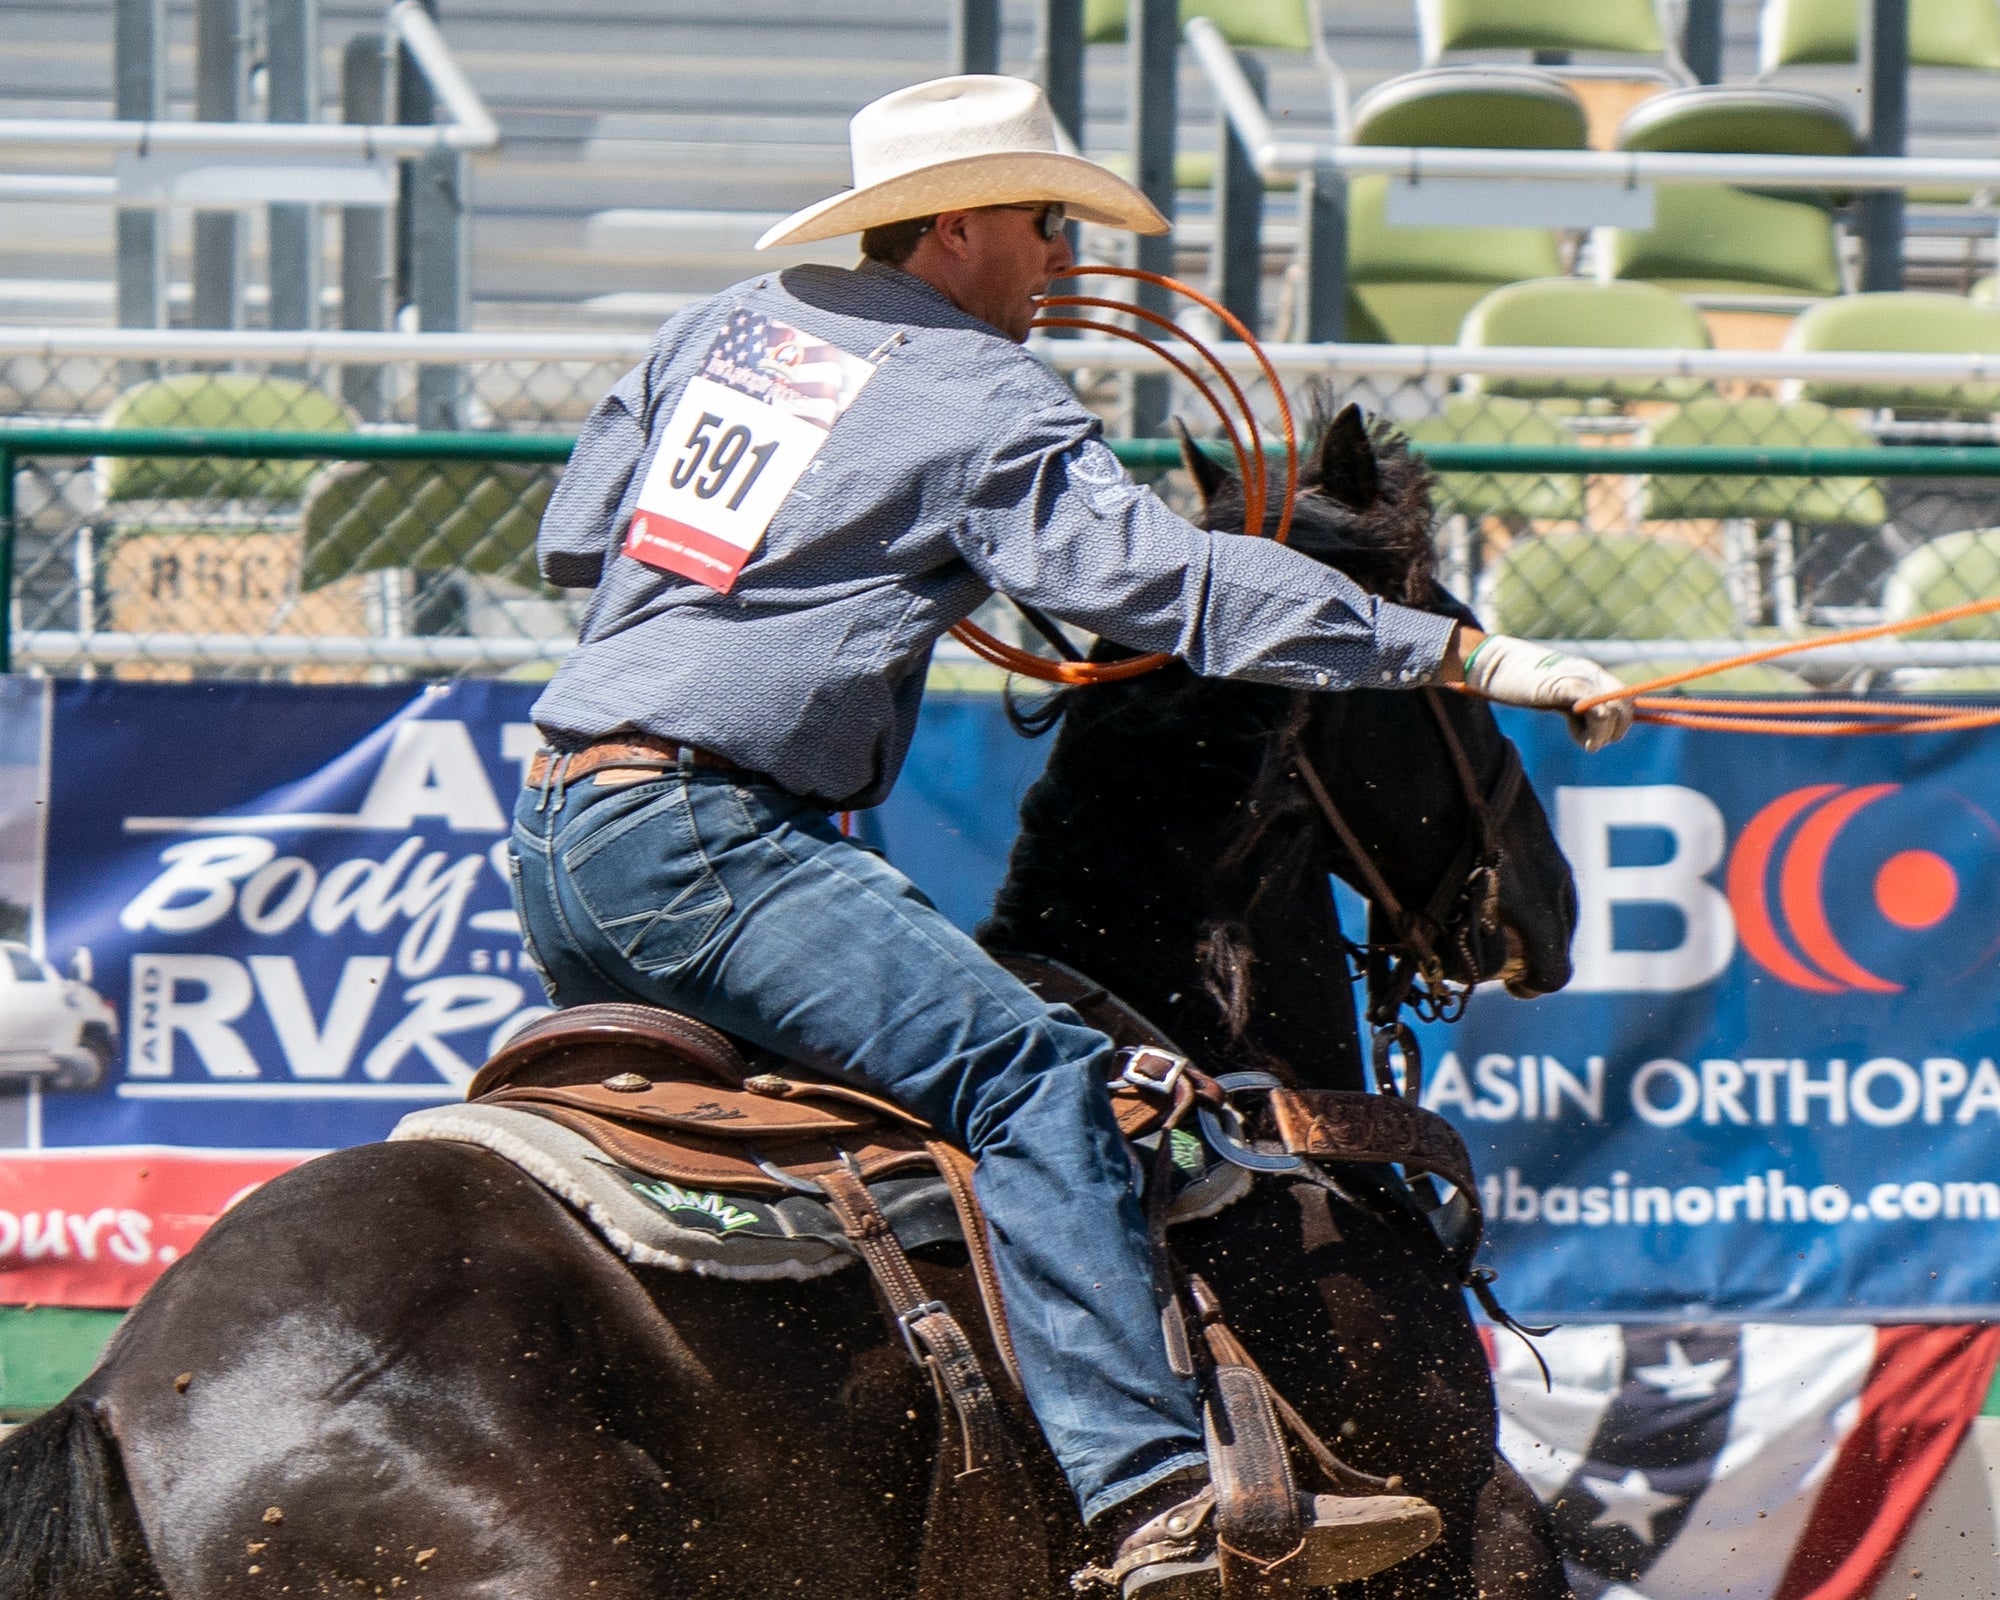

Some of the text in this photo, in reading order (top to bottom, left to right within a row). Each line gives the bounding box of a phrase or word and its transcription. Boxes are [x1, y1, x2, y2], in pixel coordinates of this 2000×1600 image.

[668, 411, 780, 511] 591
[120, 835, 485, 978] Body
[128, 952, 392, 1078] RV
[1386, 1051, 2000, 1127] ASIN ORTHOPA
[1472, 1166, 2000, 1226] tbasinortho.com
